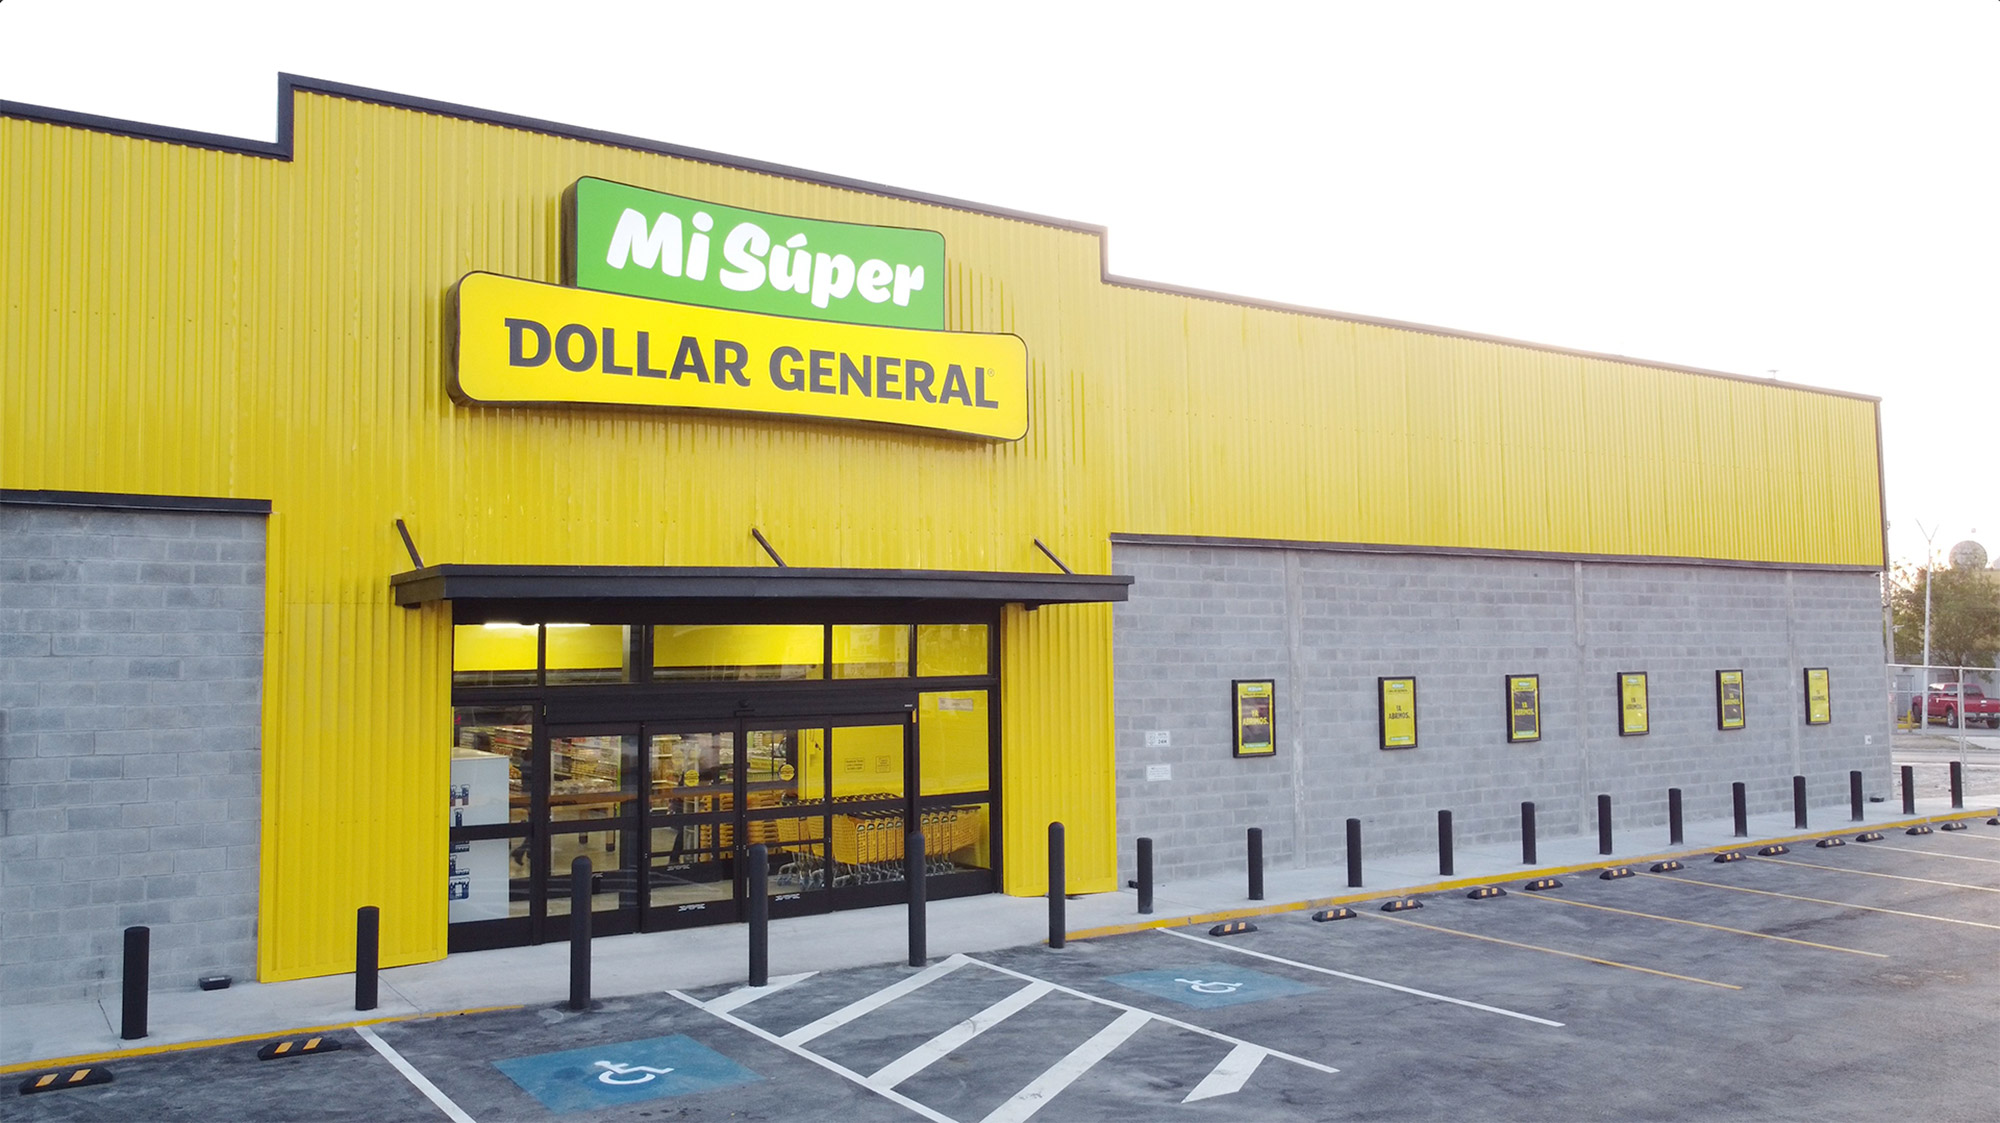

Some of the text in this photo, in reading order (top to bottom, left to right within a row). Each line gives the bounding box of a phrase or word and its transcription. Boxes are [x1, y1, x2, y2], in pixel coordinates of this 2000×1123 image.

[606, 208, 925, 310] Mi Súper
[504, 318, 998, 409] DOLLAR GENERAL
